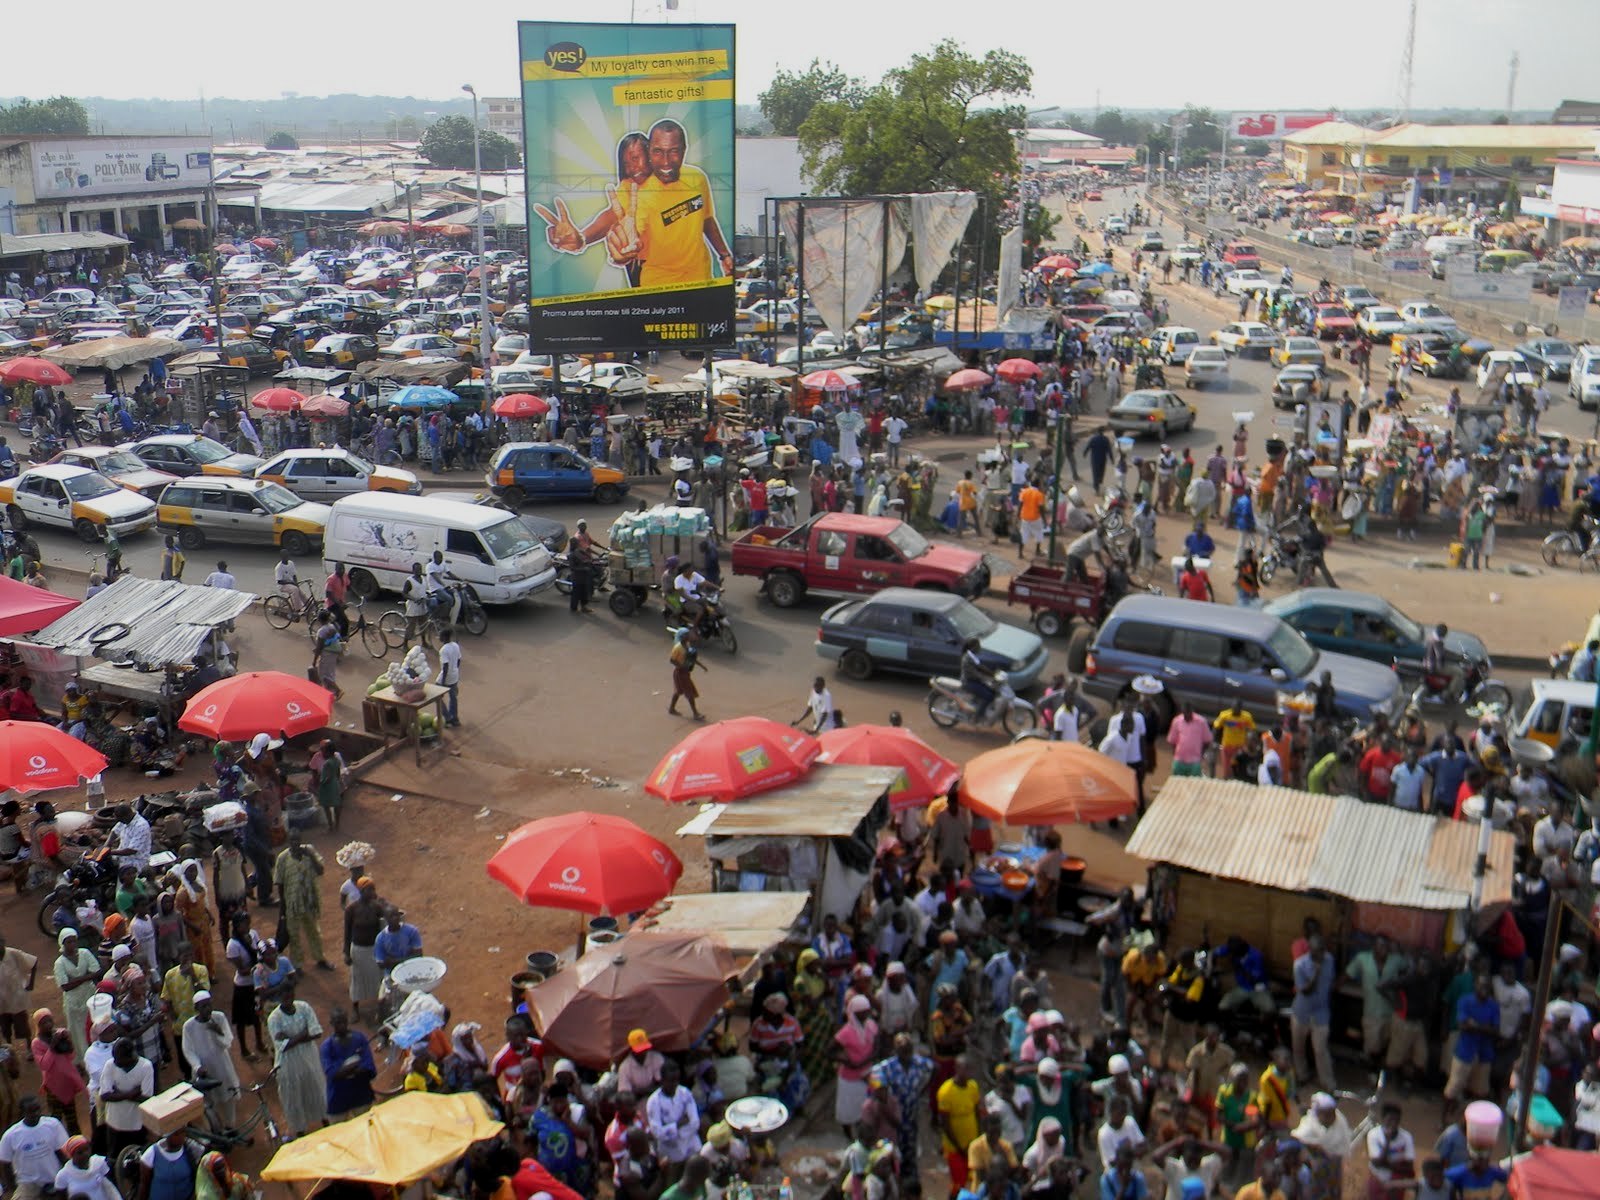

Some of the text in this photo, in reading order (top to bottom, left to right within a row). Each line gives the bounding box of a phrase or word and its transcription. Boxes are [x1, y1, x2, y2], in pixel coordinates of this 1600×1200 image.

[547, 48, 584, 68] yes!
[591, 55, 715, 74] My loyalty can win me
[624, 85, 704, 101] fantastic gifts!
[652, 307, 666, 315] July
[644, 320, 728, 338] WESTERN yes!
[661, 331, 696, 340] UNION
[25, 766, 59, 777] vodafone
[548, 881, 587, 895] vodafone
